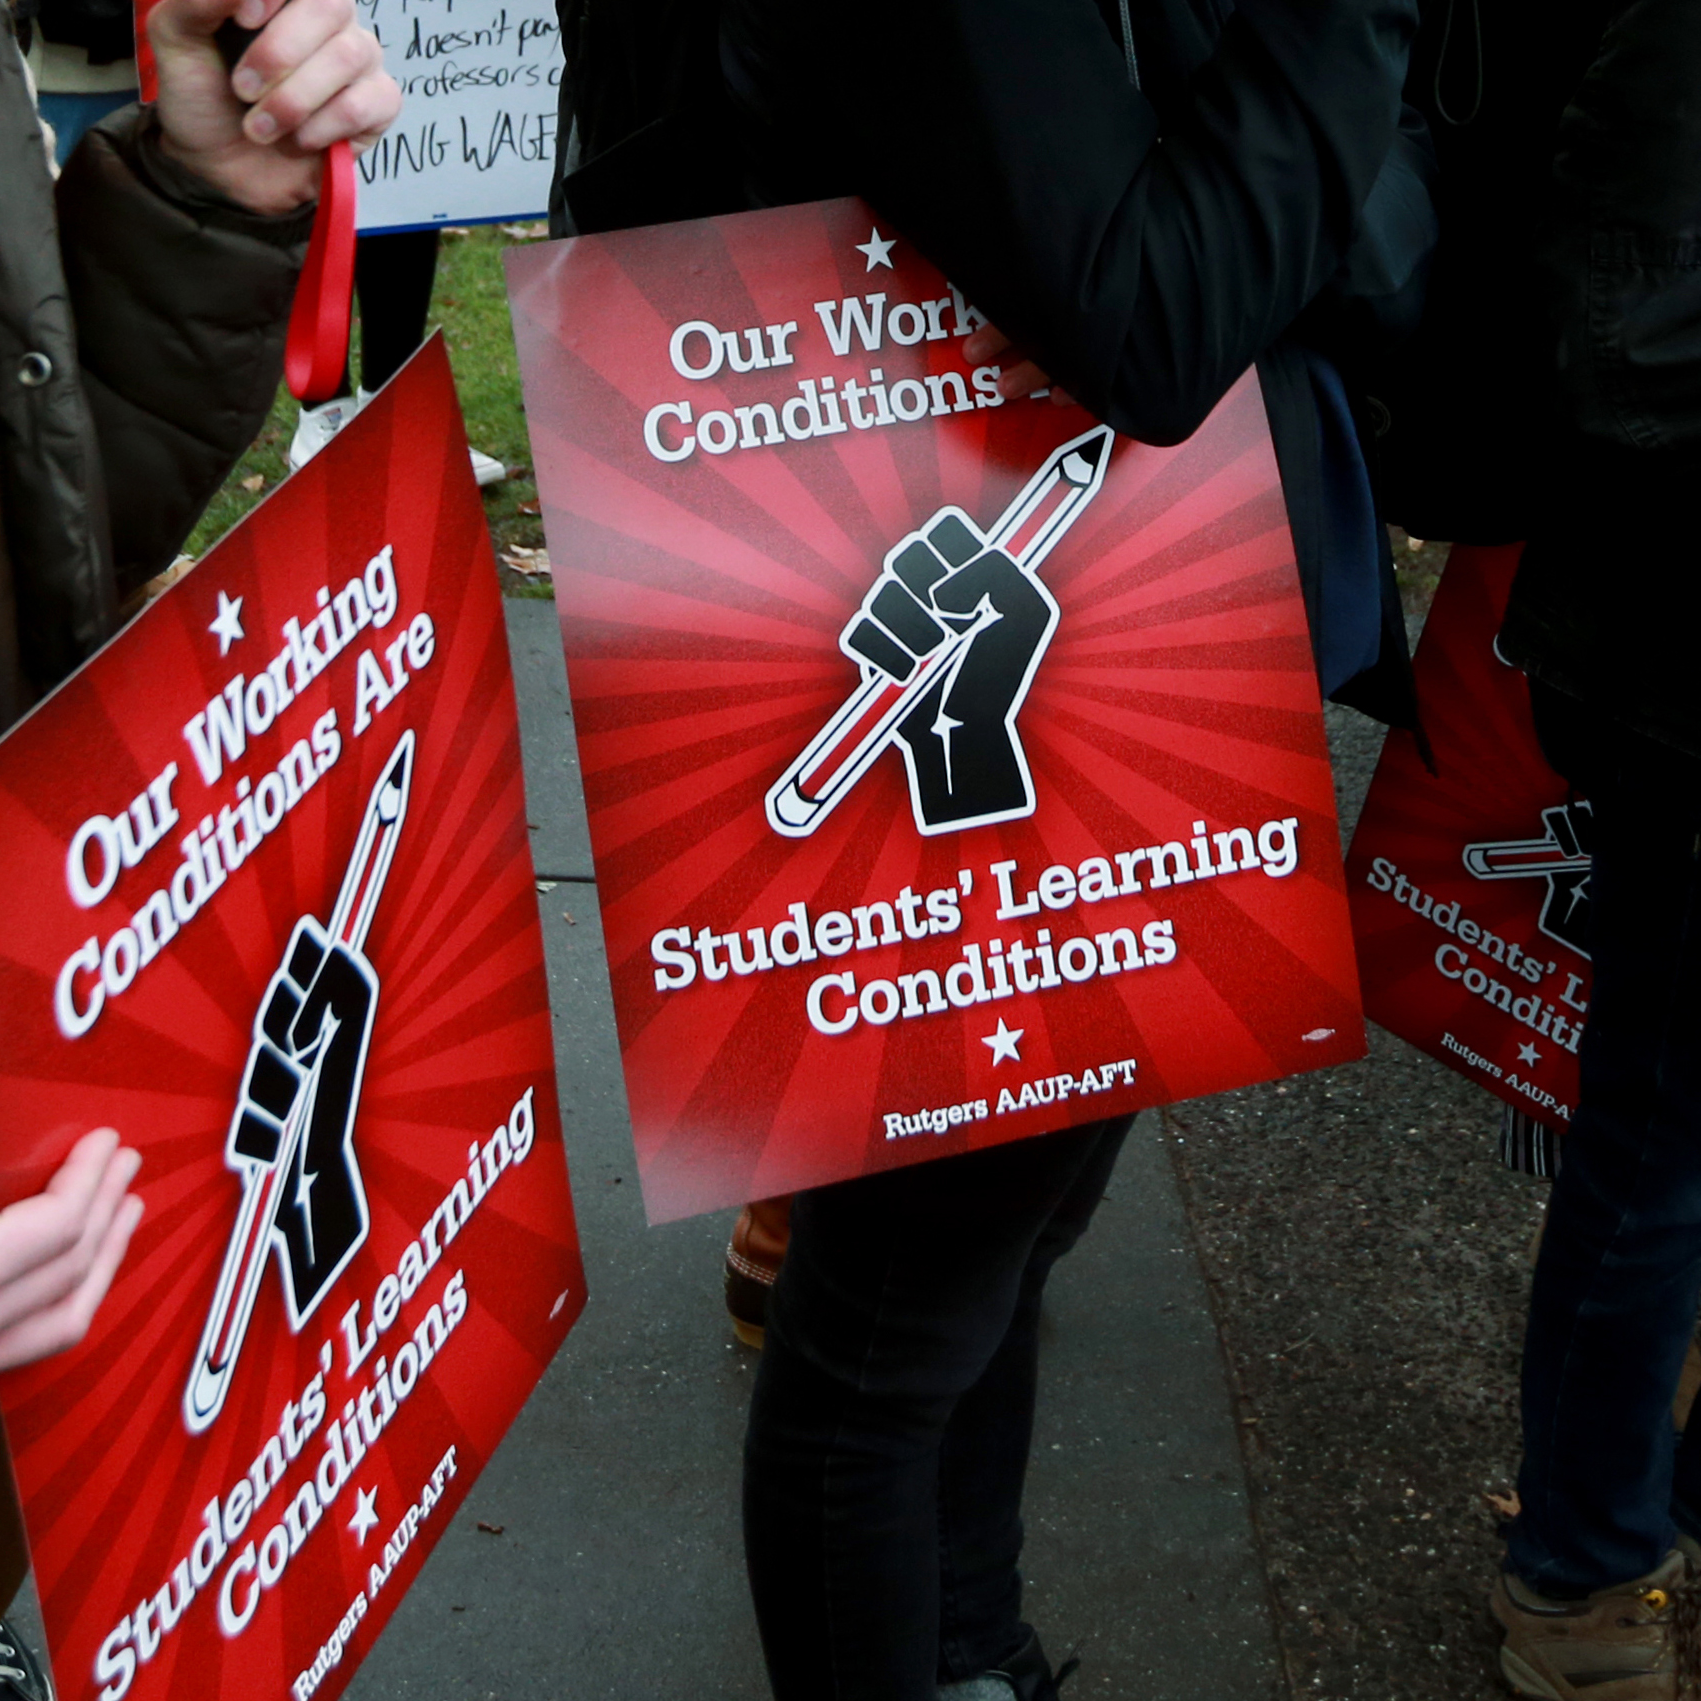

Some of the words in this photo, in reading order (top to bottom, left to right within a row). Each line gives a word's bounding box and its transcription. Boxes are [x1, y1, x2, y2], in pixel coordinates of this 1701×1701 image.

[405, 9, 513, 60] doesn't
[643, 363, 1005, 463] Conditions
[668, 318, 798, 381] Our
[66, 763, 179, 908] Our
[183, 545, 397, 786] Working
[54, 708, 341, 1040] Conditions
[353, 610, 435, 736] Are
[649, 868, 974, 990] Students'
[991, 817, 1300, 922] Learning
[1365, 855, 1557, 984] Students'
[804, 919, 1176, 1035] Conditions
[883, 1097, 989, 1141] Rutgers
[995, 1058, 1136, 1113] AAUP-AFT
[1440, 1031, 1503, 1078] Rutgers
[1504, 1073, 1576, 1121] AAUP-A
[94, 1340, 332, 1701] Students'
[340, 1086, 535, 1377] Learning
[216, 1269, 468, 1638] Conditions
[292, 1593, 367, 1700] Rutgers
[369, 1445, 458, 1598] AAUP-AFT
